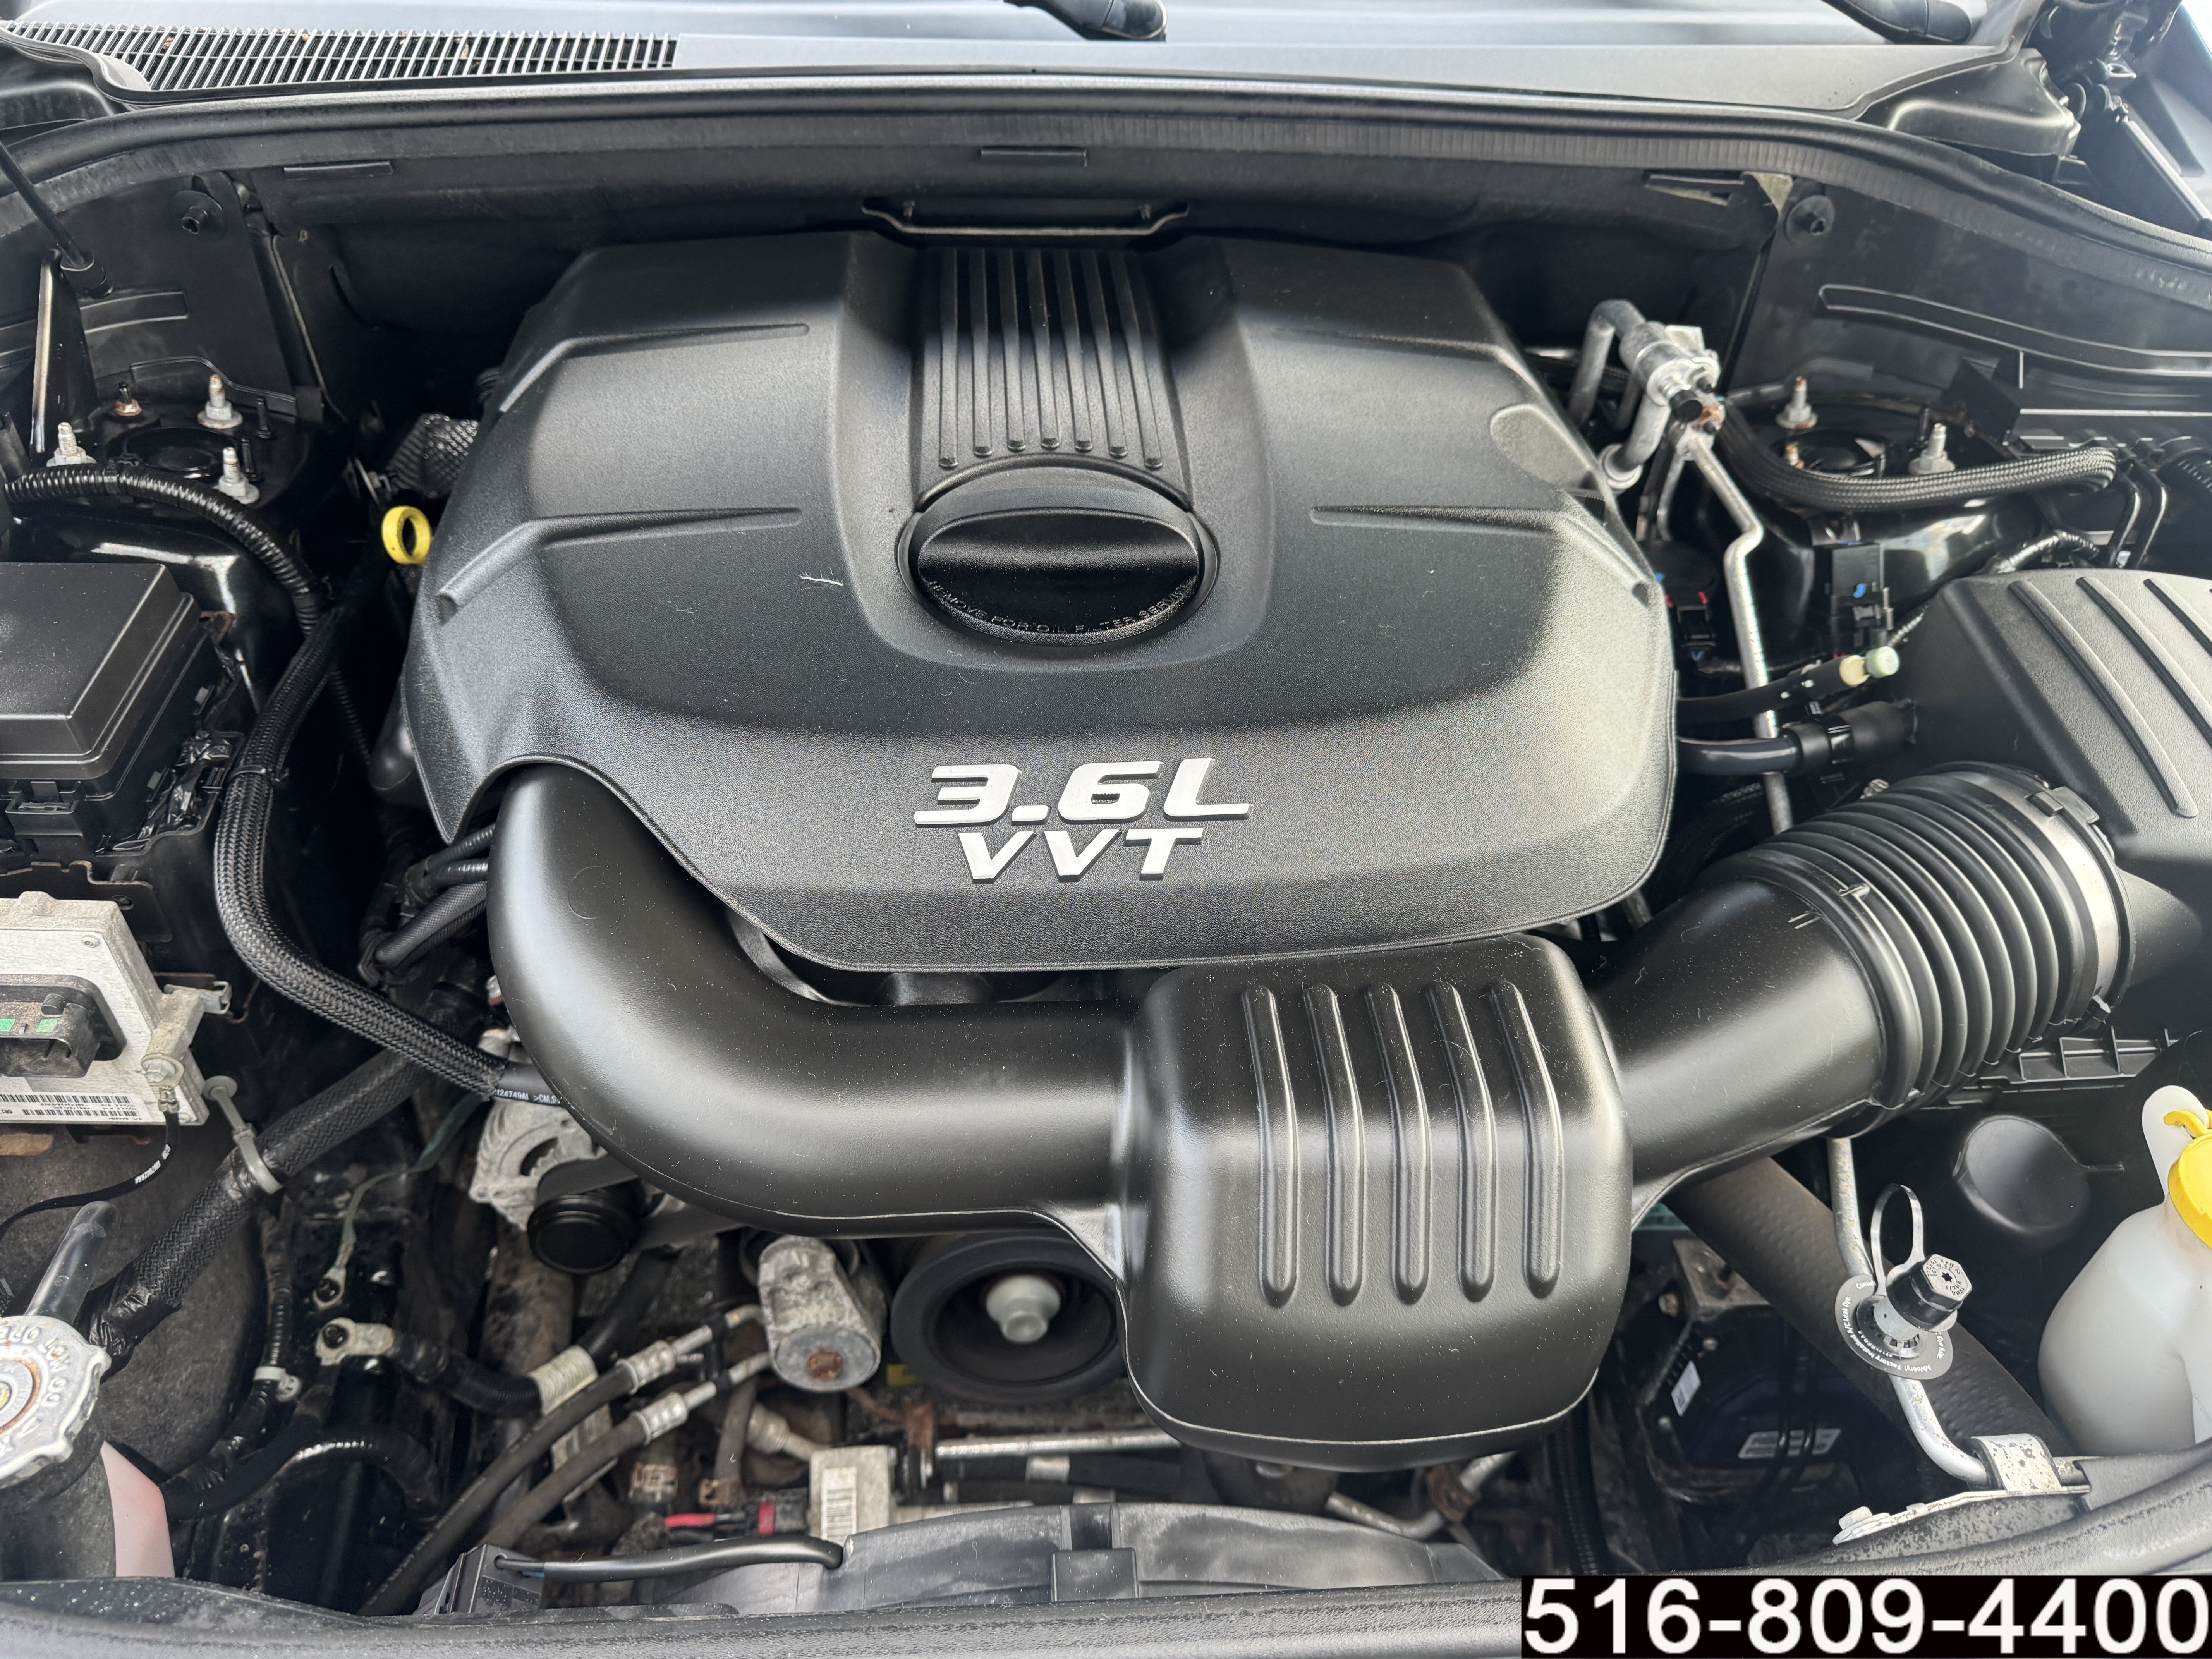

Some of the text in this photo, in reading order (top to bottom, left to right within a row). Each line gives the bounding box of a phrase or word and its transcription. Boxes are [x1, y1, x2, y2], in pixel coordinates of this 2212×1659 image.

[991, 615, 1029, 631] FOR
[914, 757, 1253, 828] 3.6L
[957, 827, 1204, 884] VVT
[1875, 1354, 1901, 1370] Factory
